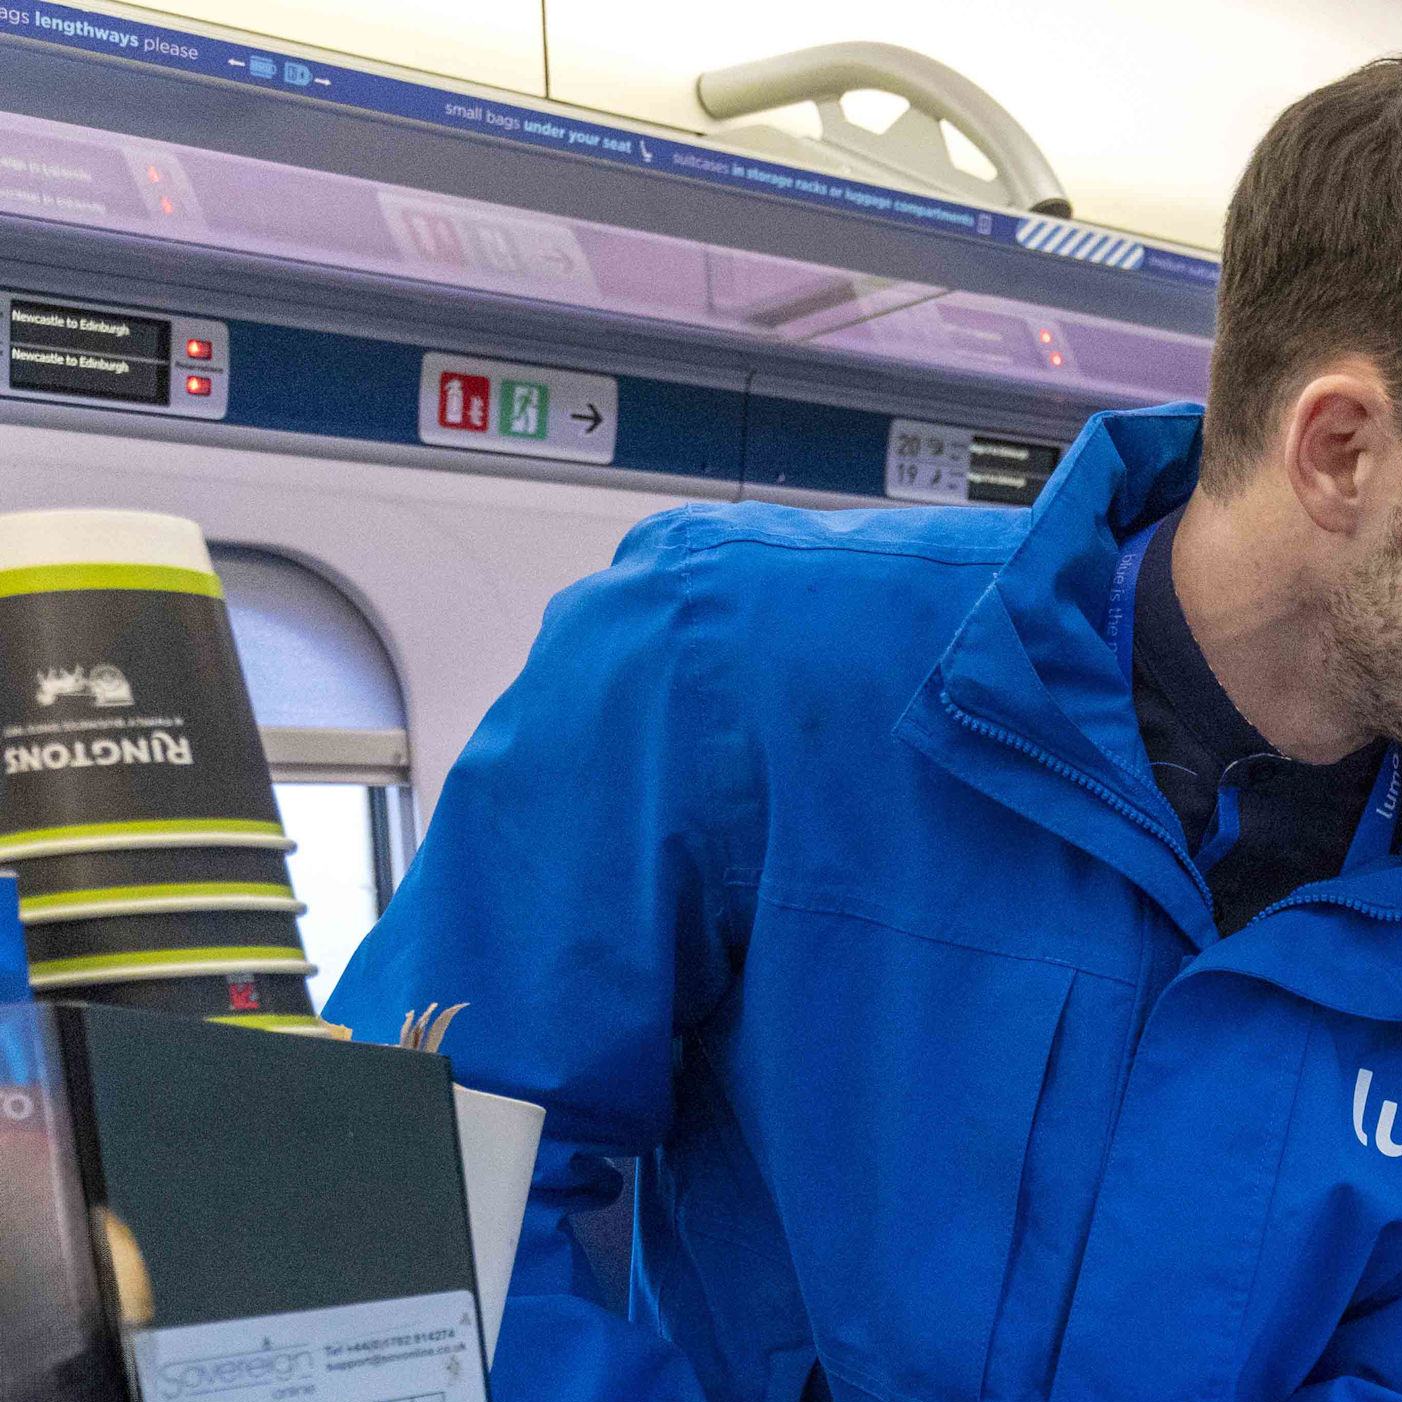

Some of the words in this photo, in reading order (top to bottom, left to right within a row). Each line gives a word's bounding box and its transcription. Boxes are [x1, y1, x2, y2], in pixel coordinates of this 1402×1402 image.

[0, 8, 30, 25] ags
[35, 11, 139, 47] lengthways
[144, 37, 199, 60] please
[444, 102, 483, 121] small
[486, 110, 521, 131] bags
[524, 119, 565, 139] under
[568, 129, 600, 147] your
[602, 137, 632, 154] seat
[673, 152, 730, 175] suitcases
[731, 163, 746, 178] in
[746, 167, 793, 189] storage
[11, 309, 65, 329] Newcastle
[66, 317, 78, 329] to
[79, 319, 130, 337] Edinburgh
[11, 347, 65, 367] Newcastle
[66, 355, 78, 367] to
[79, 356, 130, 375] Edinburgh
[4, 730, 194, 774] RINGTONS
[158, 1345, 314, 1400] Sovereign
